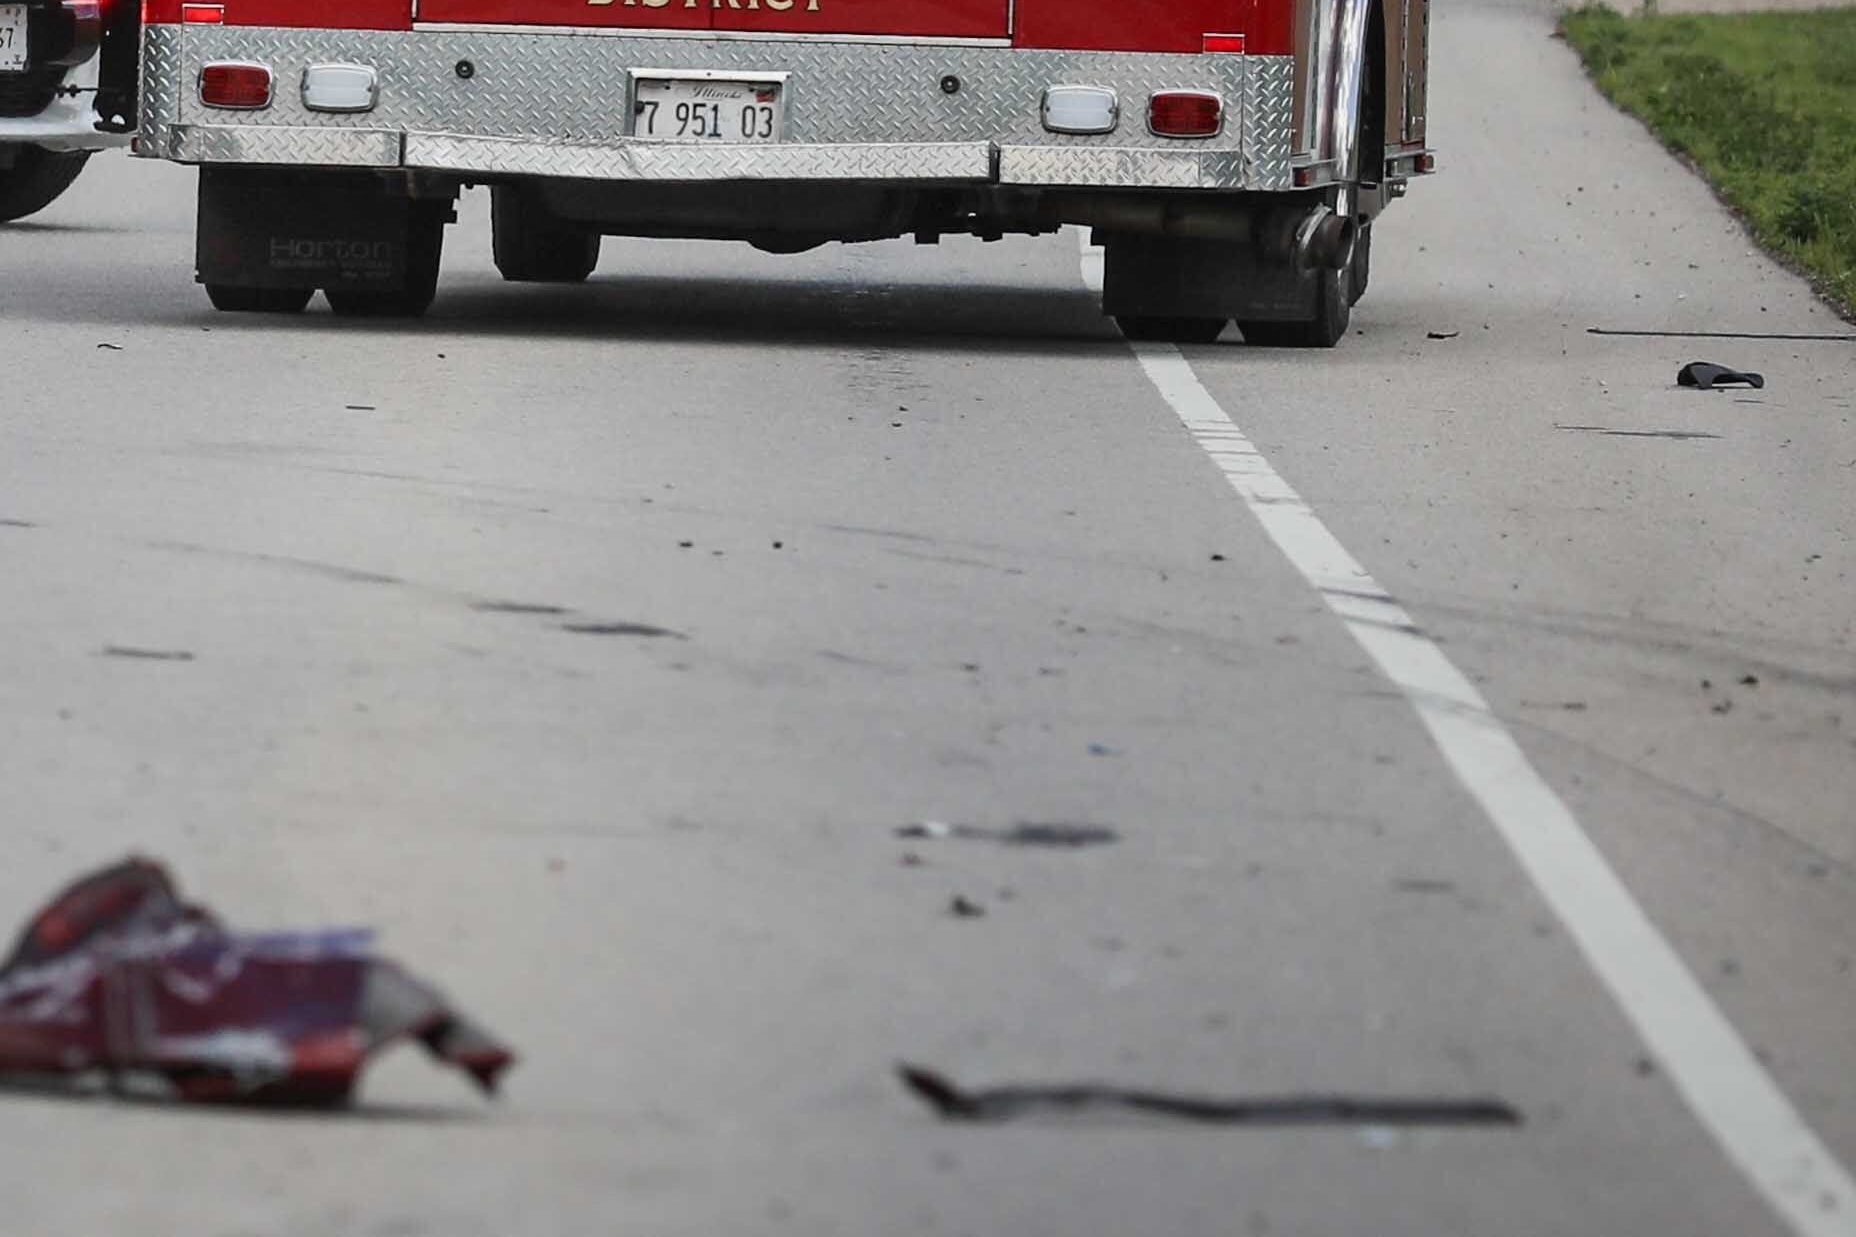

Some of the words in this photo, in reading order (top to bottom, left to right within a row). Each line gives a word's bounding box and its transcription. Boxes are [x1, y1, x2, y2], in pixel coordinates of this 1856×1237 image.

[644, 101, 659, 135] 7
[676, 102, 722, 138] 951
[741, 105, 774, 139] 03
